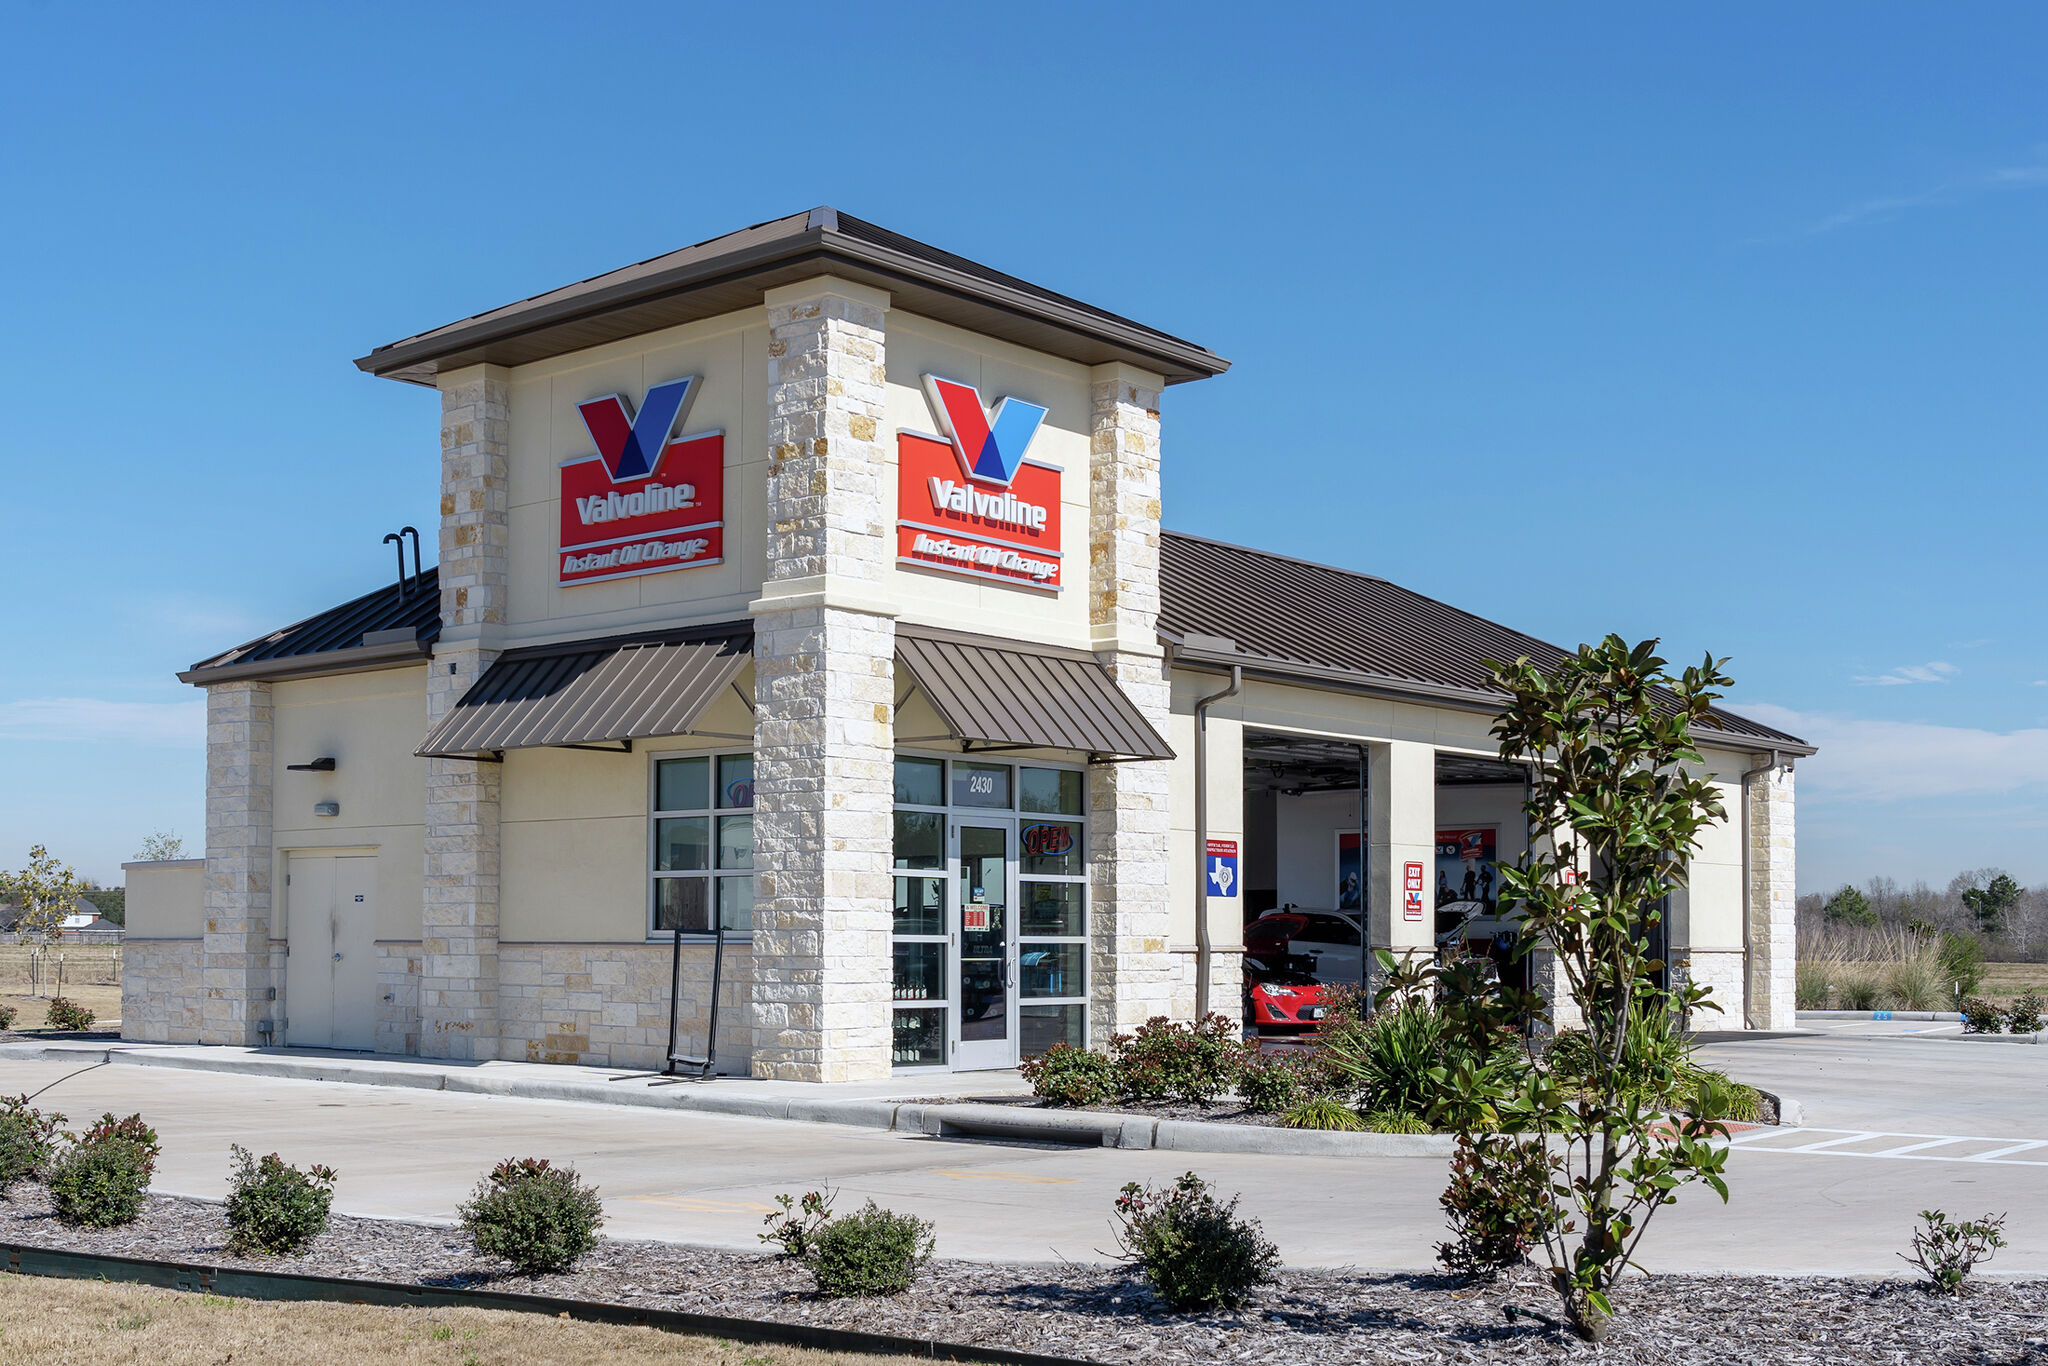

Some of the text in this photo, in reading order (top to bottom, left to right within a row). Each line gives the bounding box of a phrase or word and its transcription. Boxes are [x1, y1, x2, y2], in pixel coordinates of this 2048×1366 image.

[576, 483, 696, 525] Valvoline
[927, 476, 1047, 531] Valvoline
[562, 538, 709, 574] Instant Oil Change
[912, 533, 1059, 579] Instant Oil Change
[970, 775, 993, 794] 2430
[1027, 826, 1071, 855] OPEN
[1407, 878, 1421, 889] ONLY
[1408, 866, 1421, 878] EXIT
